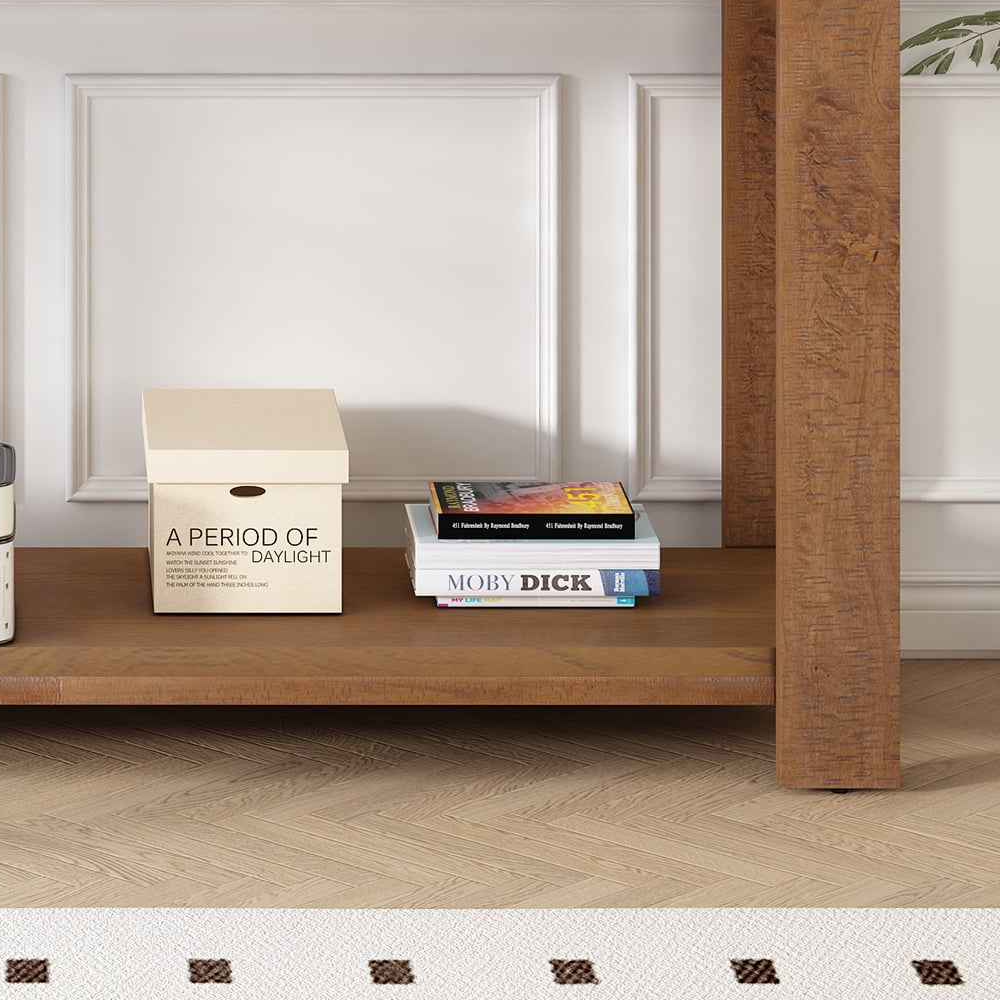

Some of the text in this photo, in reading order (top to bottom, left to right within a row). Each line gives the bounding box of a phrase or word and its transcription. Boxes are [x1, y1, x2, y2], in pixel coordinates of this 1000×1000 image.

[456, 482, 480, 512] BRADBURY
[563, 487, 602, 509] 451
[166, 528, 318, 546] A PERIOD OF
[252, 550, 331, 563] DAYLIGHT
[448, 574, 592, 591] MOBY DICK
